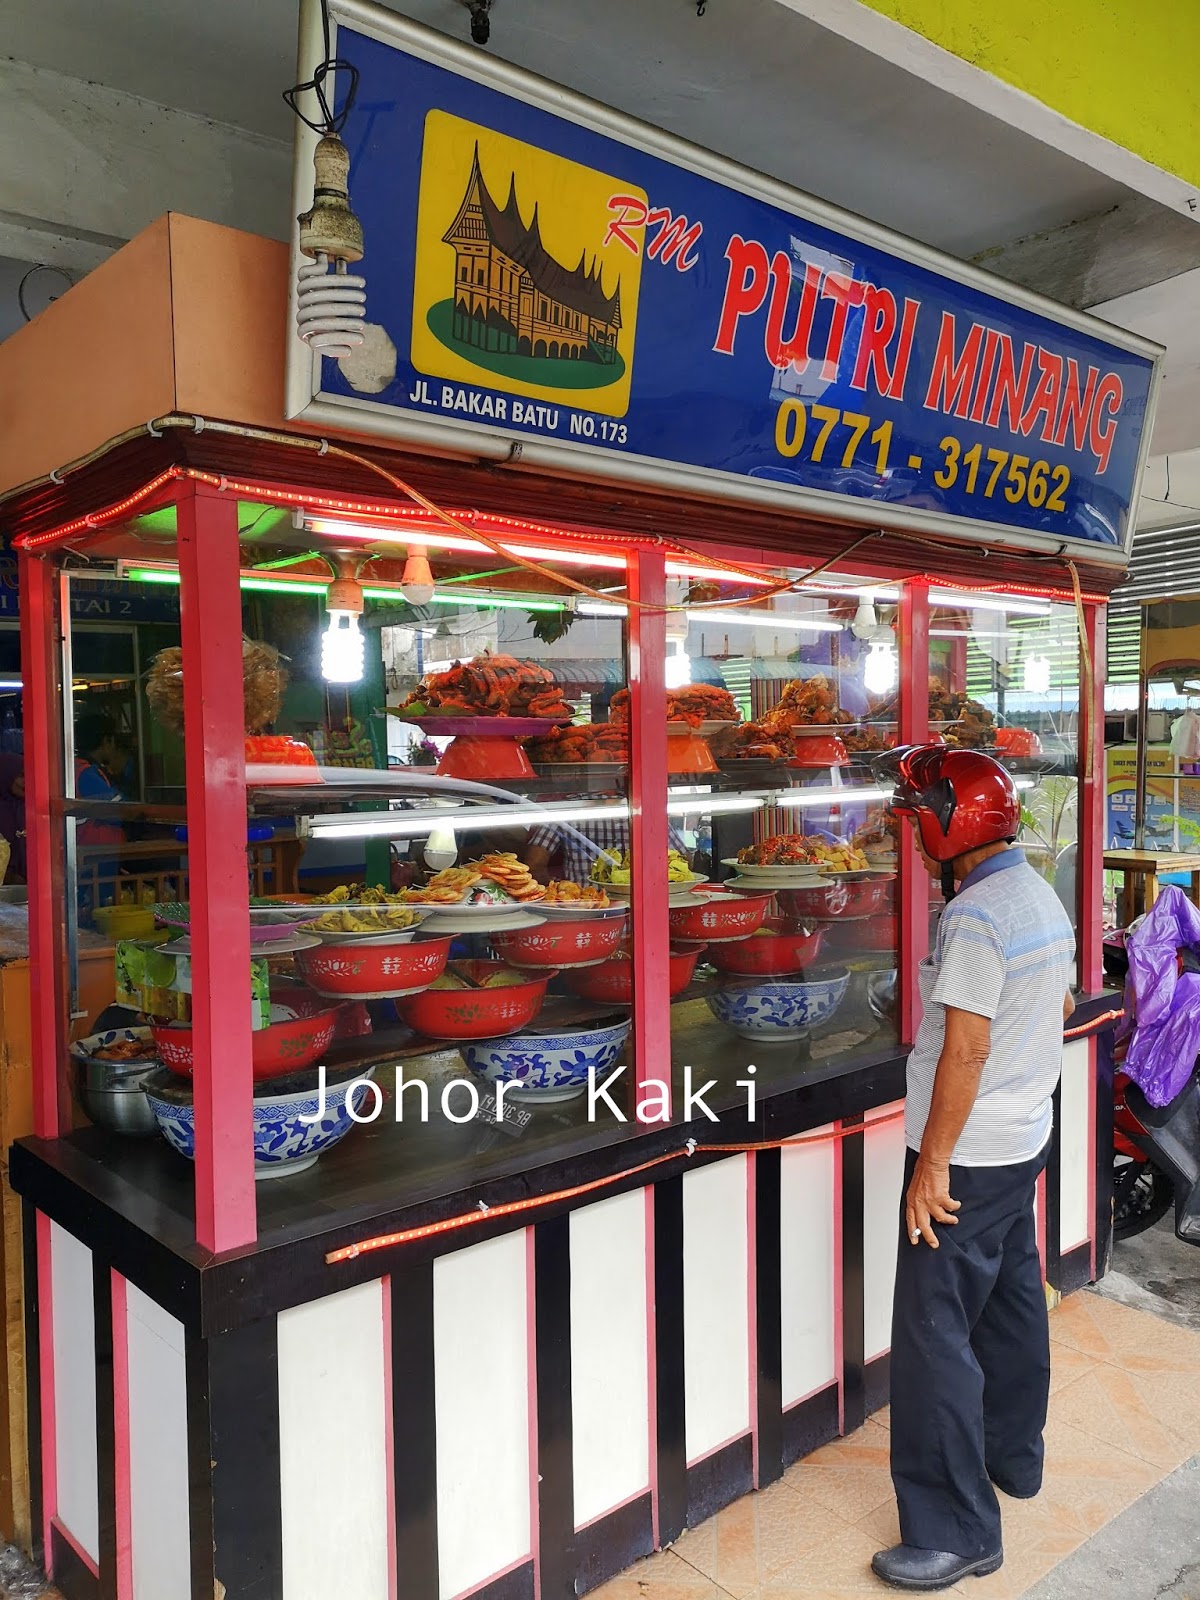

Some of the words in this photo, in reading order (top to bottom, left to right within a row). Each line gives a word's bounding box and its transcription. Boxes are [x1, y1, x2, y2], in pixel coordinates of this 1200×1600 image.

[604, 194, 704, 271] RM
[712, 233, 921, 402] PUTRI
[923, 311, 1124, 476] MINANG
[409, 380, 437, 406] JL.
[441, 386, 507, 420] BAKAR
[512, 402, 559, 430] BATU
[775, 398, 894, 475] 0771
[933, 436, 1070, 513] 317562
